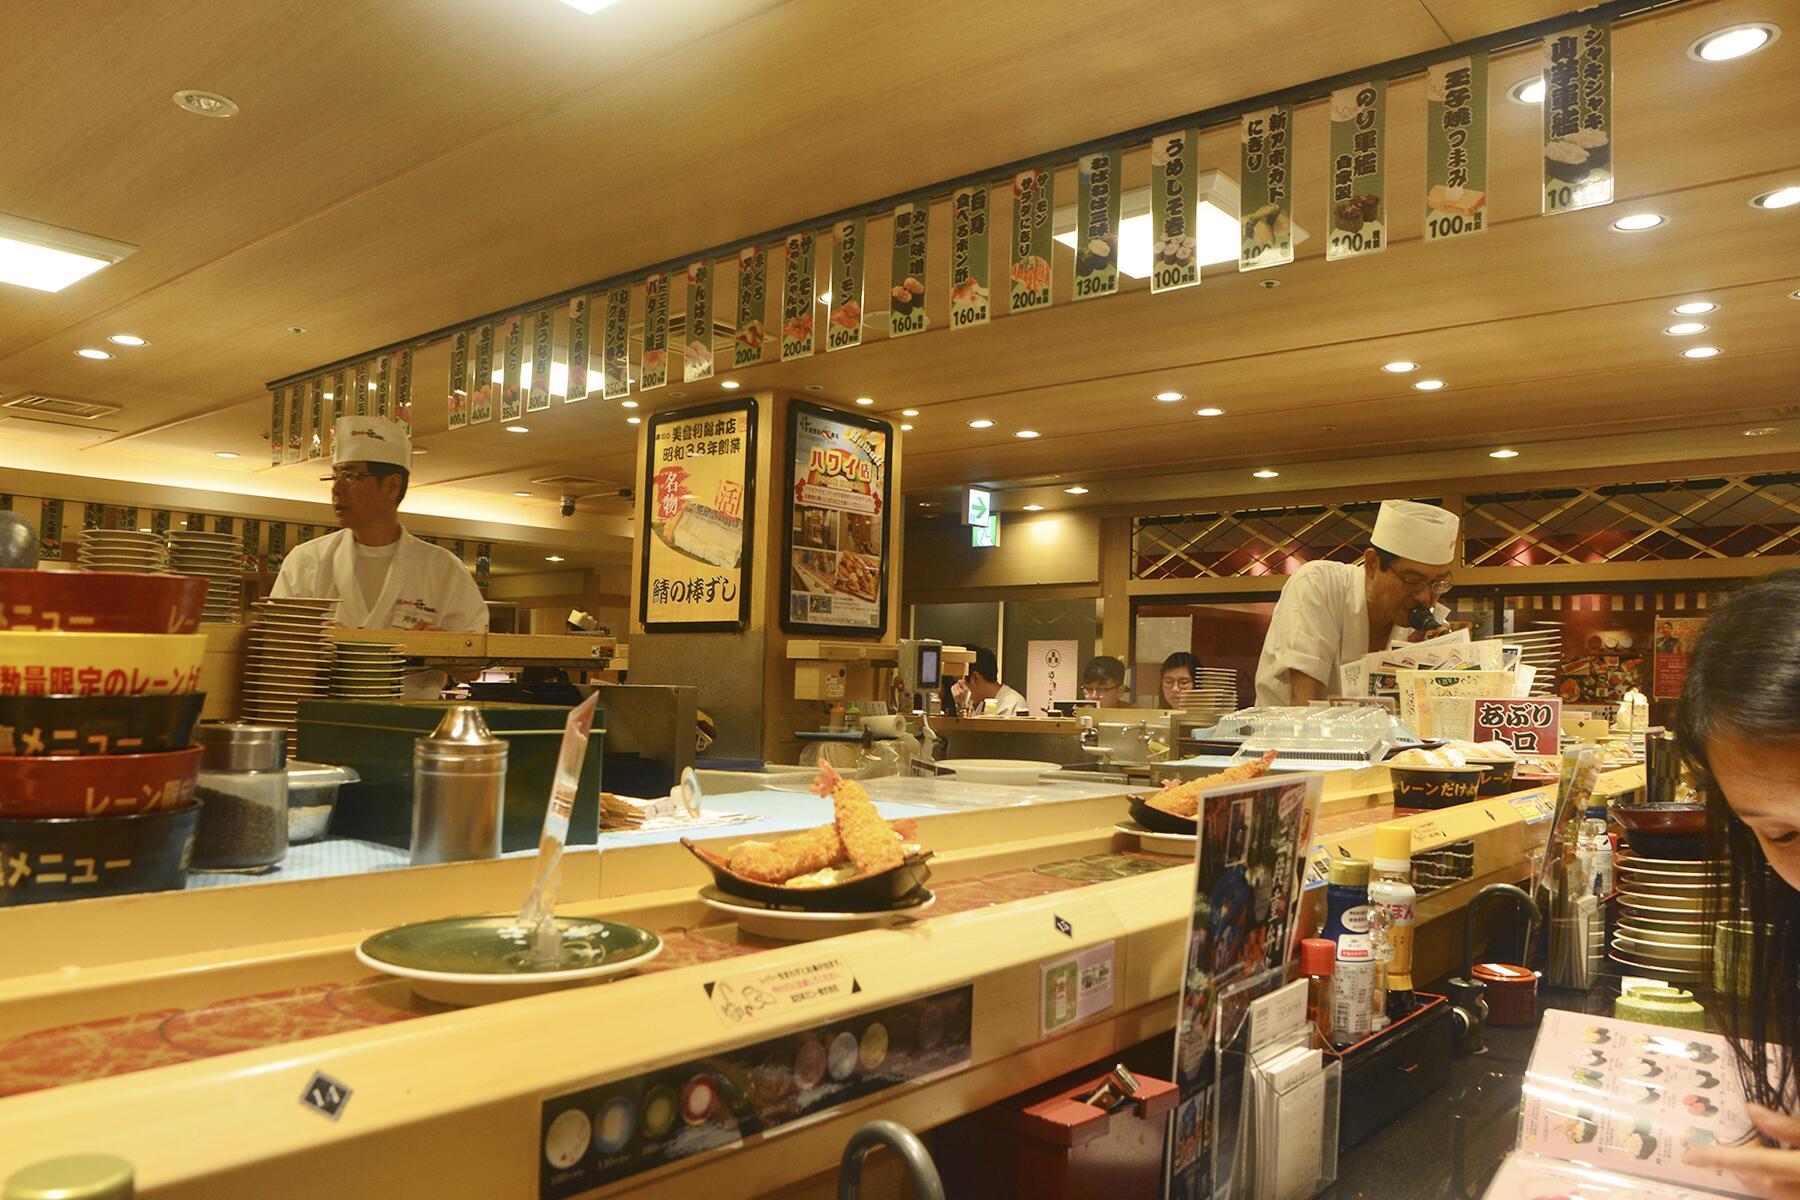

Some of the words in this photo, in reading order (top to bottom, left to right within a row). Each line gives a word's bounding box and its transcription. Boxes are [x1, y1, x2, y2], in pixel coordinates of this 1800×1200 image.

[1584, 29, 1604, 130] シャキシャキ
[1247, 119, 1264, 172] にぎり
[1353, 87, 1377, 177] のり軍艦
[969, 188, 987, 236] 白身
[1034, 172, 1048, 228] サーモン
[1164, 137, 1185, 238] うめしそ巻
[1019, 176, 1033, 257] サラダにぎり
[663, 437, 741, 462] 昭和38年創業
[663, 471, 678, 516] 名物
[653, 575, 737, 605] 鯖の棒ずし
[1480, 703, 1553, 728] あぶり
[1491, 729, 1539, 753] トロ
